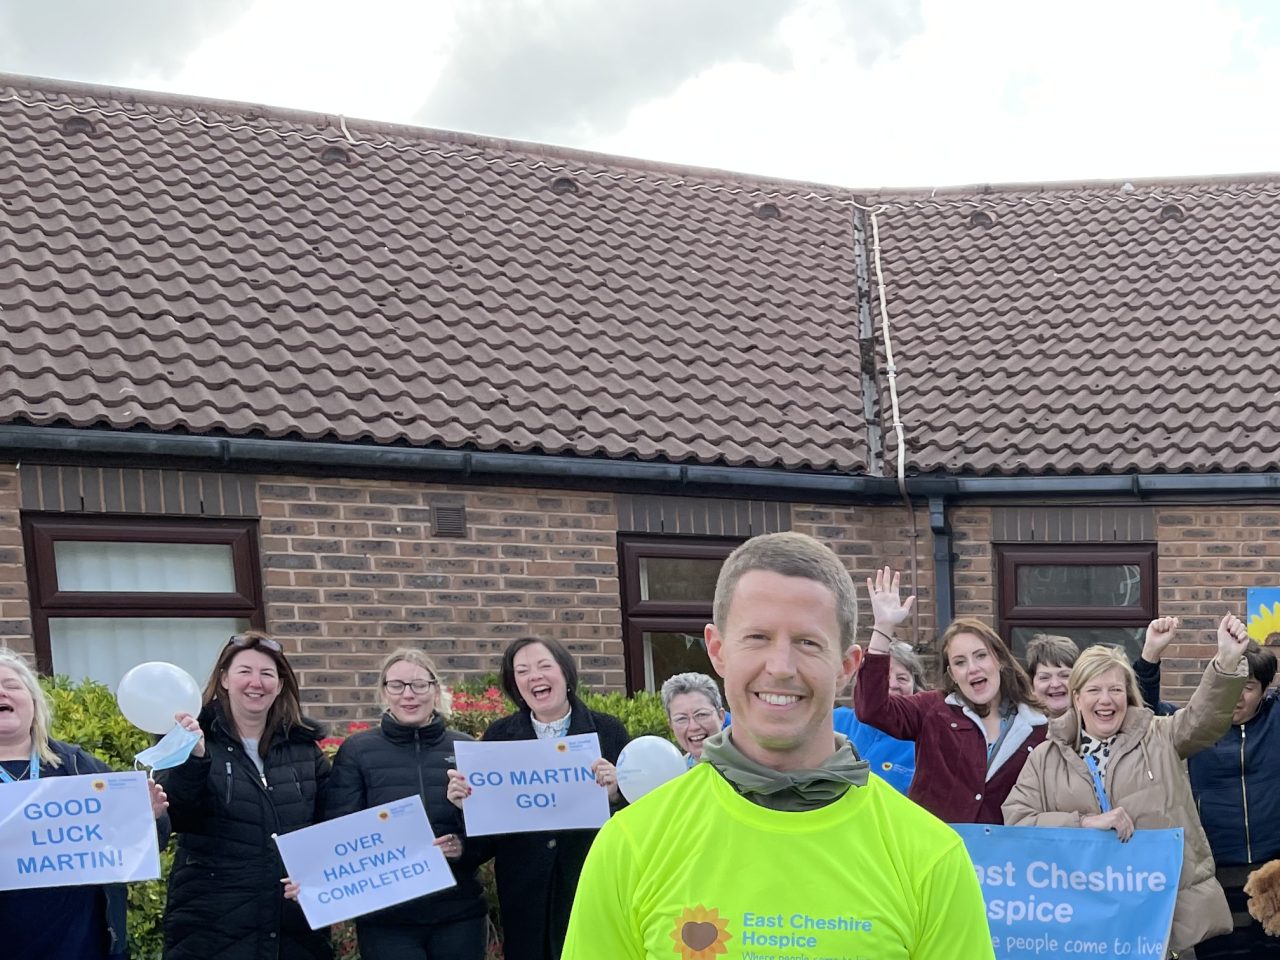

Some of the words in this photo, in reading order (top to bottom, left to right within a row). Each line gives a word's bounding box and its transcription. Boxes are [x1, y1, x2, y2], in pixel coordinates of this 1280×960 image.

[468, 771, 503, 787] GO
[510, 766, 596, 786] MARTIN
[24, 797, 101, 820] GOOD
[516, 793, 557, 809] GO!
[31, 824, 103, 846] LUCK
[335, 832, 384, 857] OVER
[16, 850, 124, 874] MARTIN!
[323, 846, 407, 882] HALFWAY
[318, 860, 431, 904] COMPLETED!
[1026, 861, 1167, 892] Cheshire
[743, 912, 784, 928] East
[790, 914, 872, 932] Cheshire
[988, 894, 1074, 926] spice
[742, 931, 817, 949] Hospice
[1006, 932, 1059, 955] people
[1064, 940, 1108, 954] come
[1114, 937, 1131, 956] to
[1137, 935, 1163, 955] live
